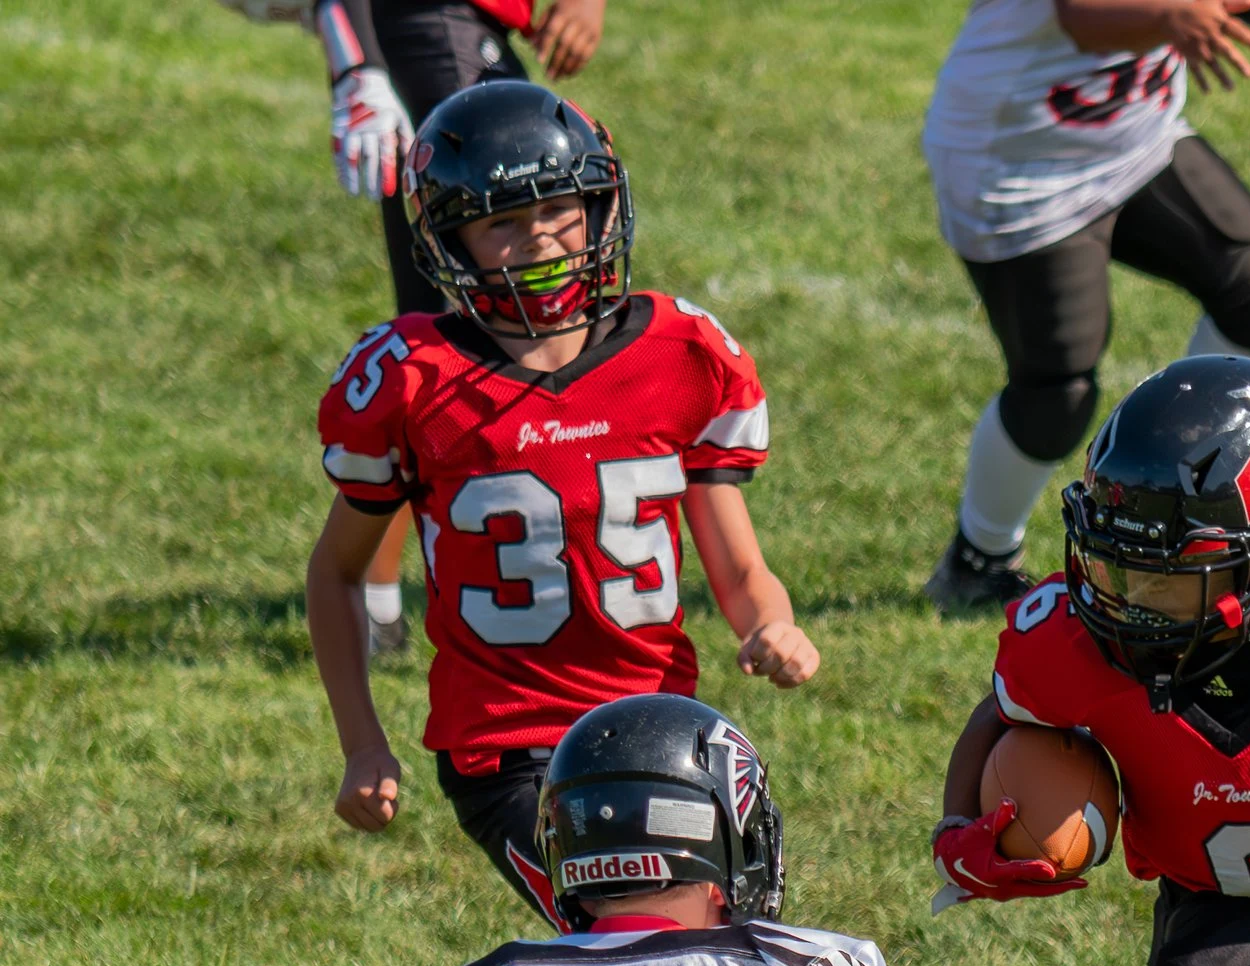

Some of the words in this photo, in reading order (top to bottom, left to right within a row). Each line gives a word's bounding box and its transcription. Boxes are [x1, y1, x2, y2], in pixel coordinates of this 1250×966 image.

[1113, 516, 1146, 534] schutt
[449, 454, 688, 647] 35
[563, 854, 662, 885] Riddell
